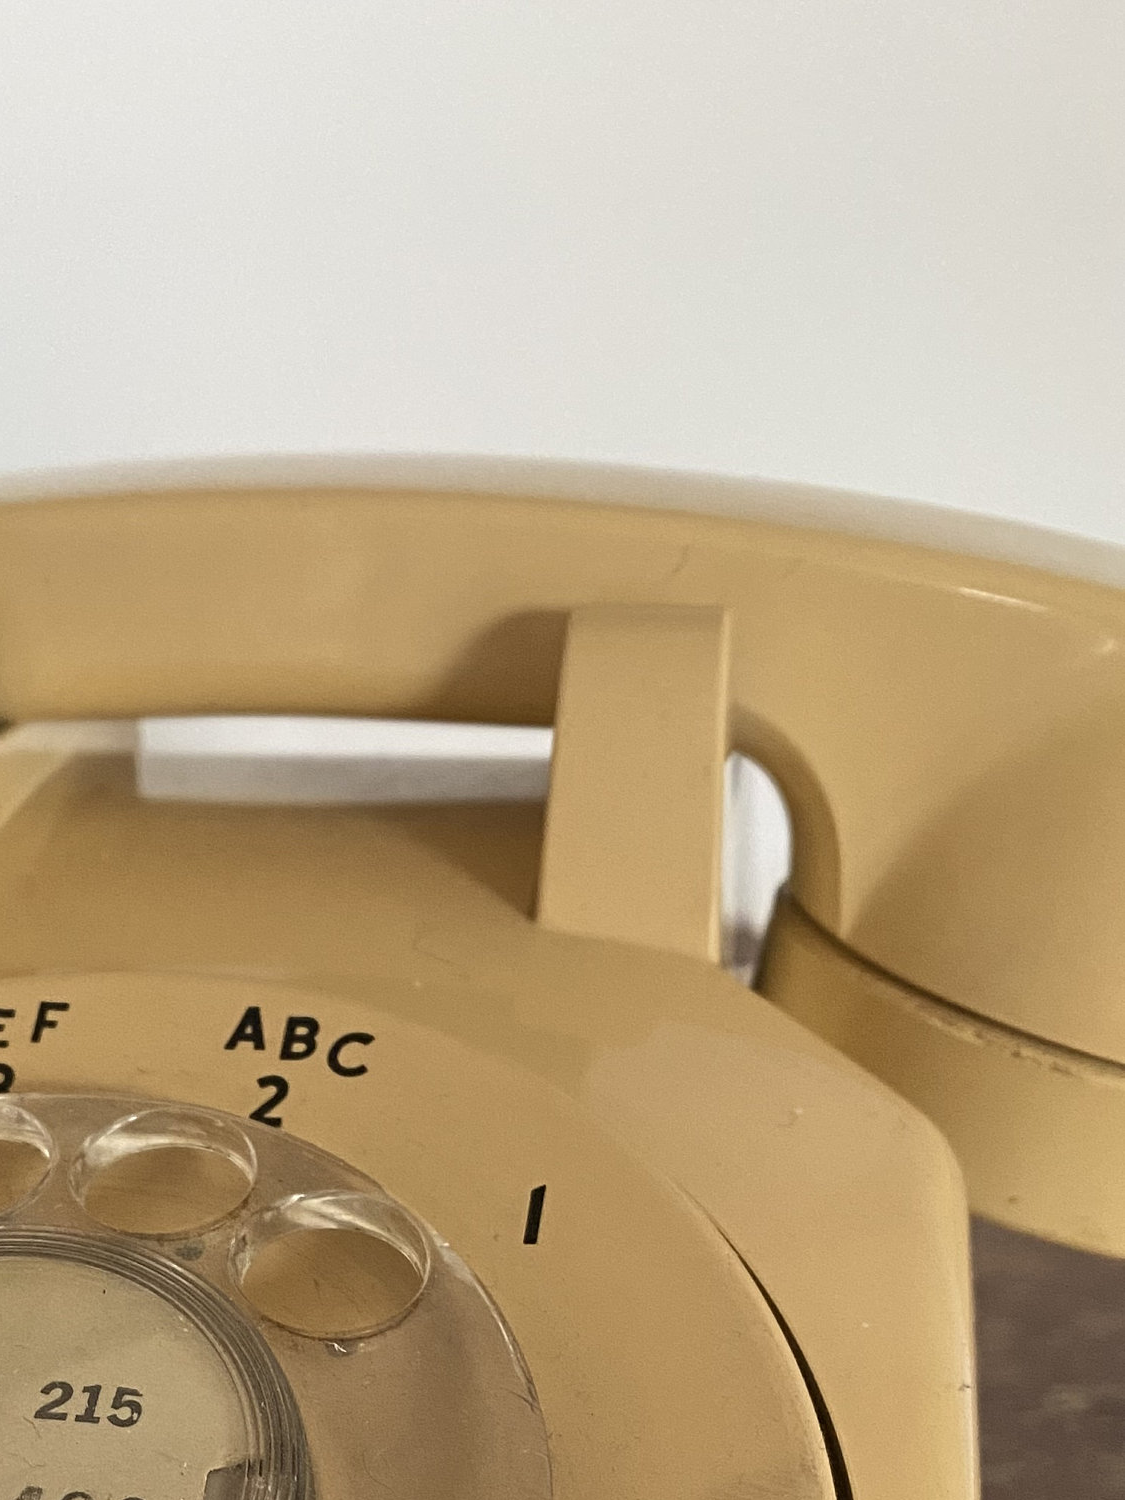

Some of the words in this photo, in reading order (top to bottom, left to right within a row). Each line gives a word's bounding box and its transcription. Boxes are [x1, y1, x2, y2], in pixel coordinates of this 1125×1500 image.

[223, 1006, 376, 1078] ABC
[248, 1074, 290, 1128] 2
[33, 1381, 145, 1428] 215
